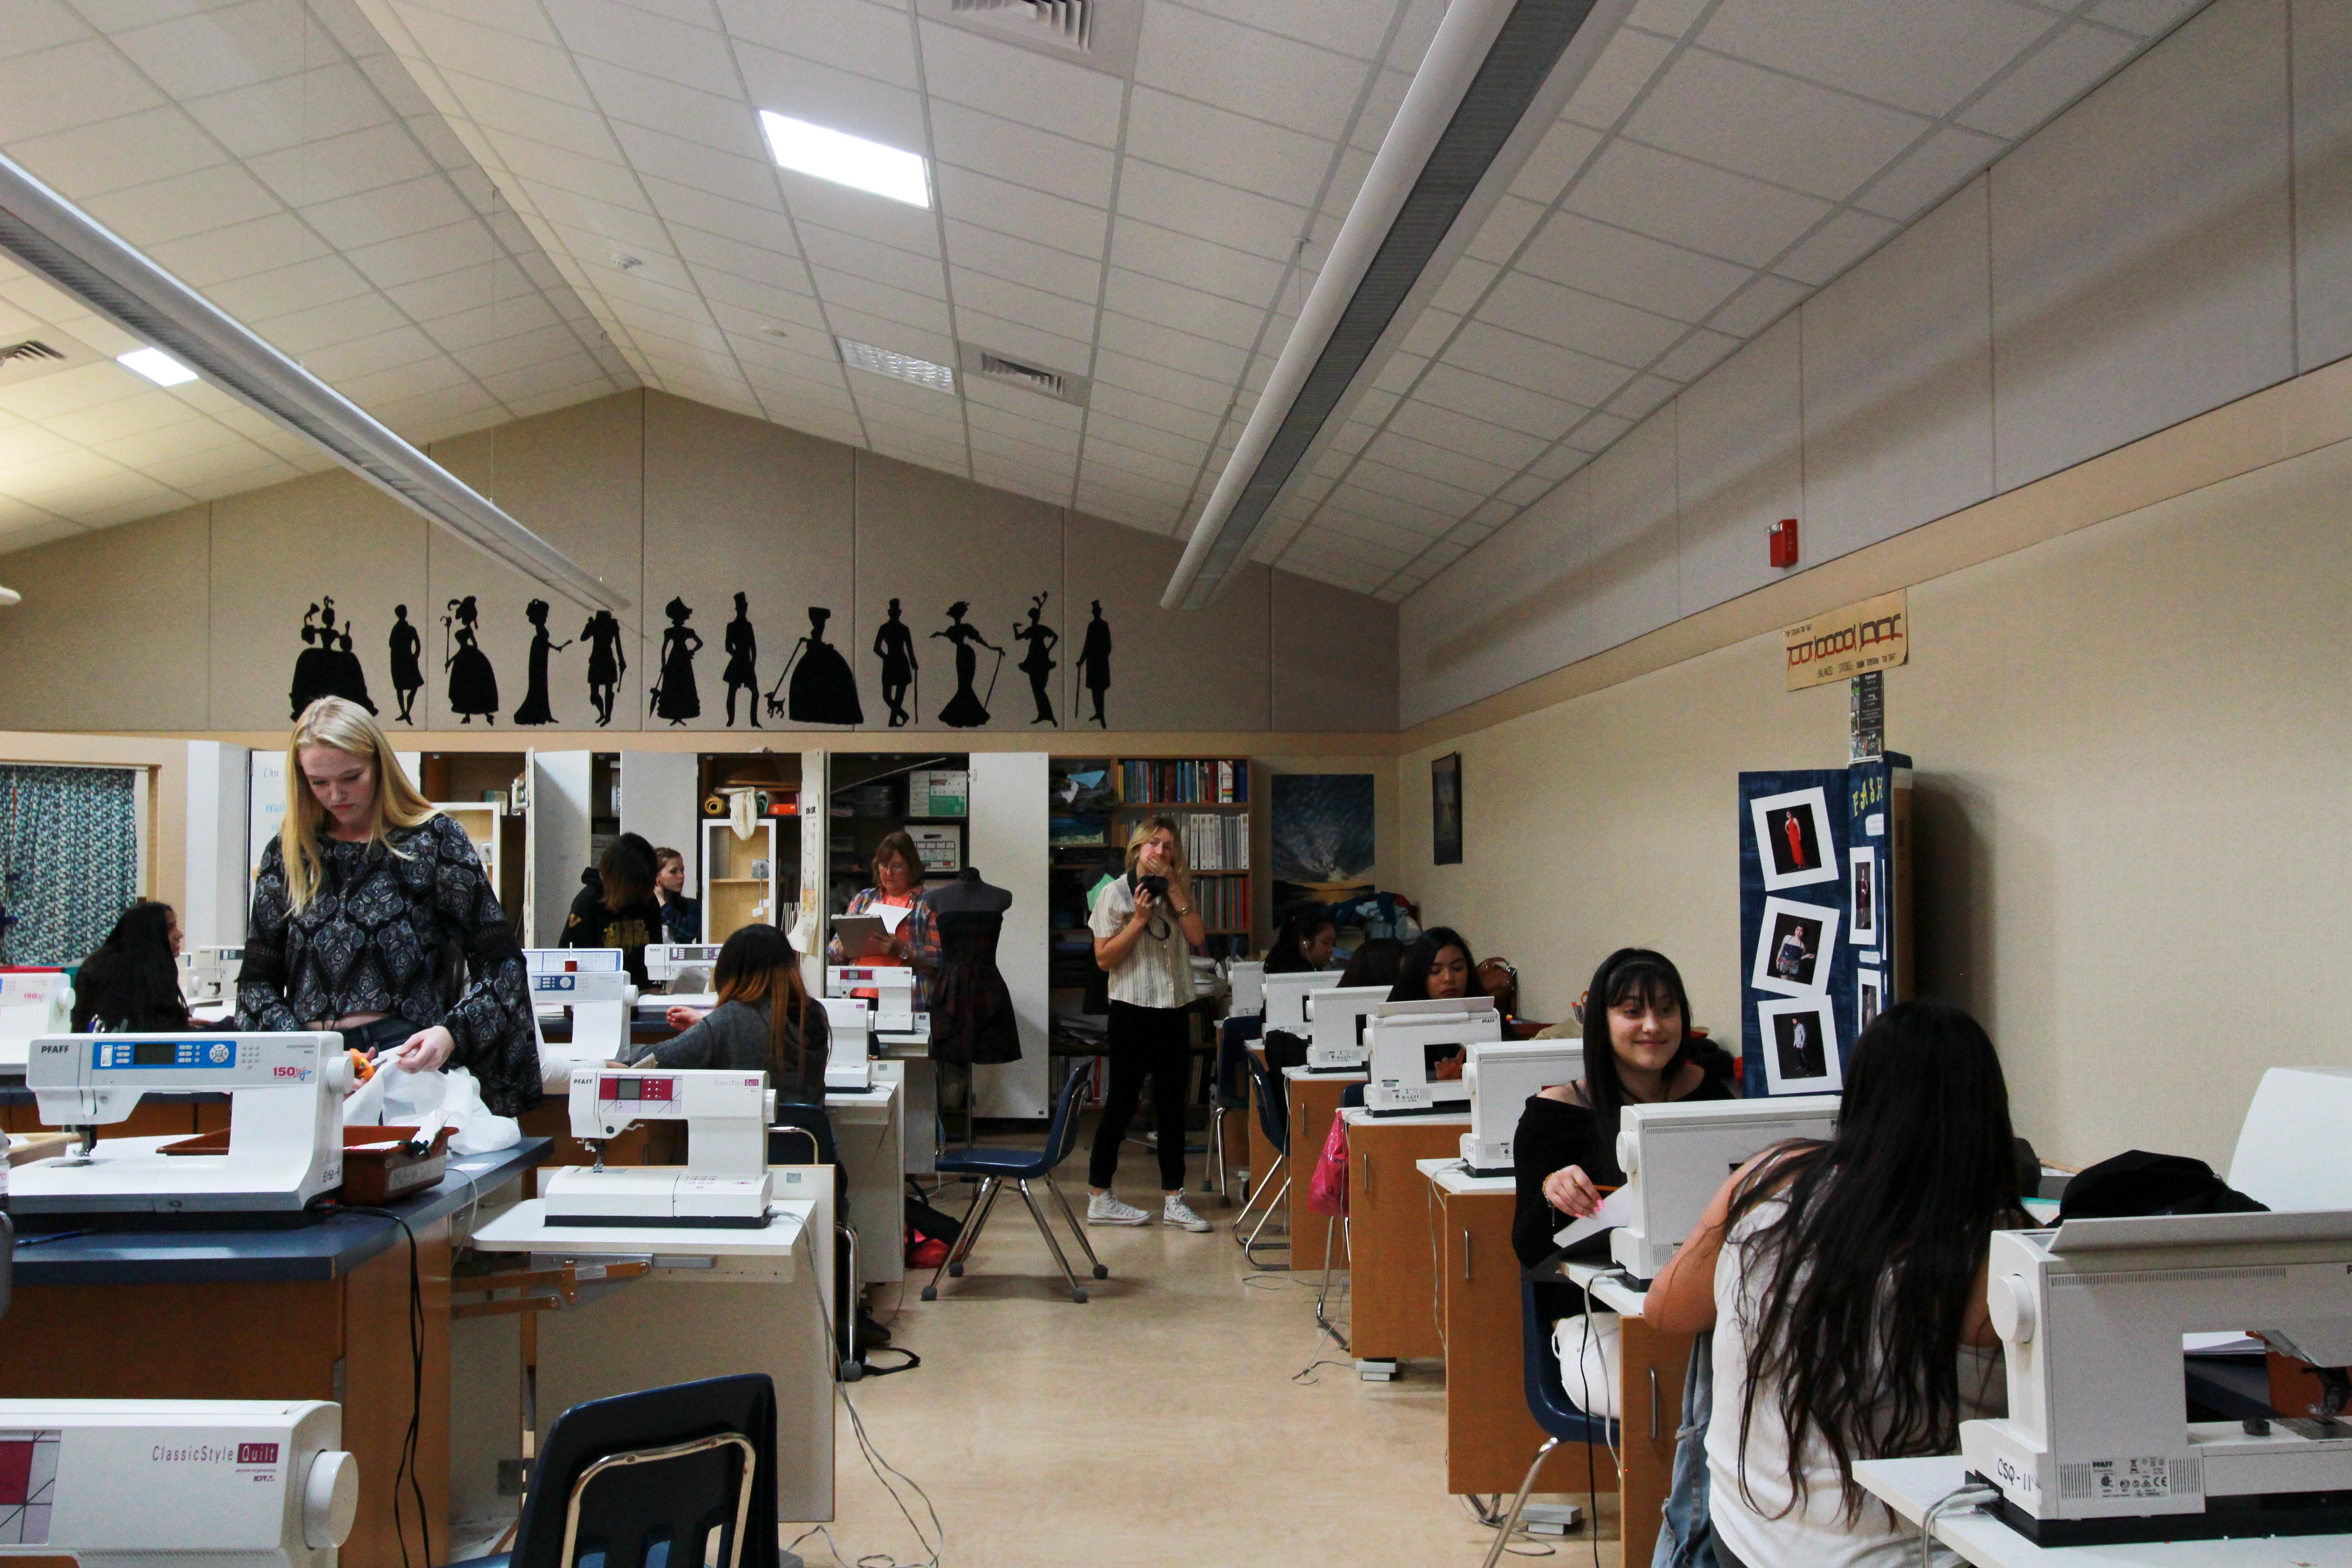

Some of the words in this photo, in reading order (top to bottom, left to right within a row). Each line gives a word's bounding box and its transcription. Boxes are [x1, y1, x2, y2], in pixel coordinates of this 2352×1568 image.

[264, 766, 279, 778] Our
[41, 1045, 69, 1054] PFAFF
[273, 1067, 295, 1076] 150
[152, 1446, 233, 1464] ClassicStyle
[242, 1446, 274, 1461] Quilt
[1998, 1458, 2030, 1491] CSQ-11
